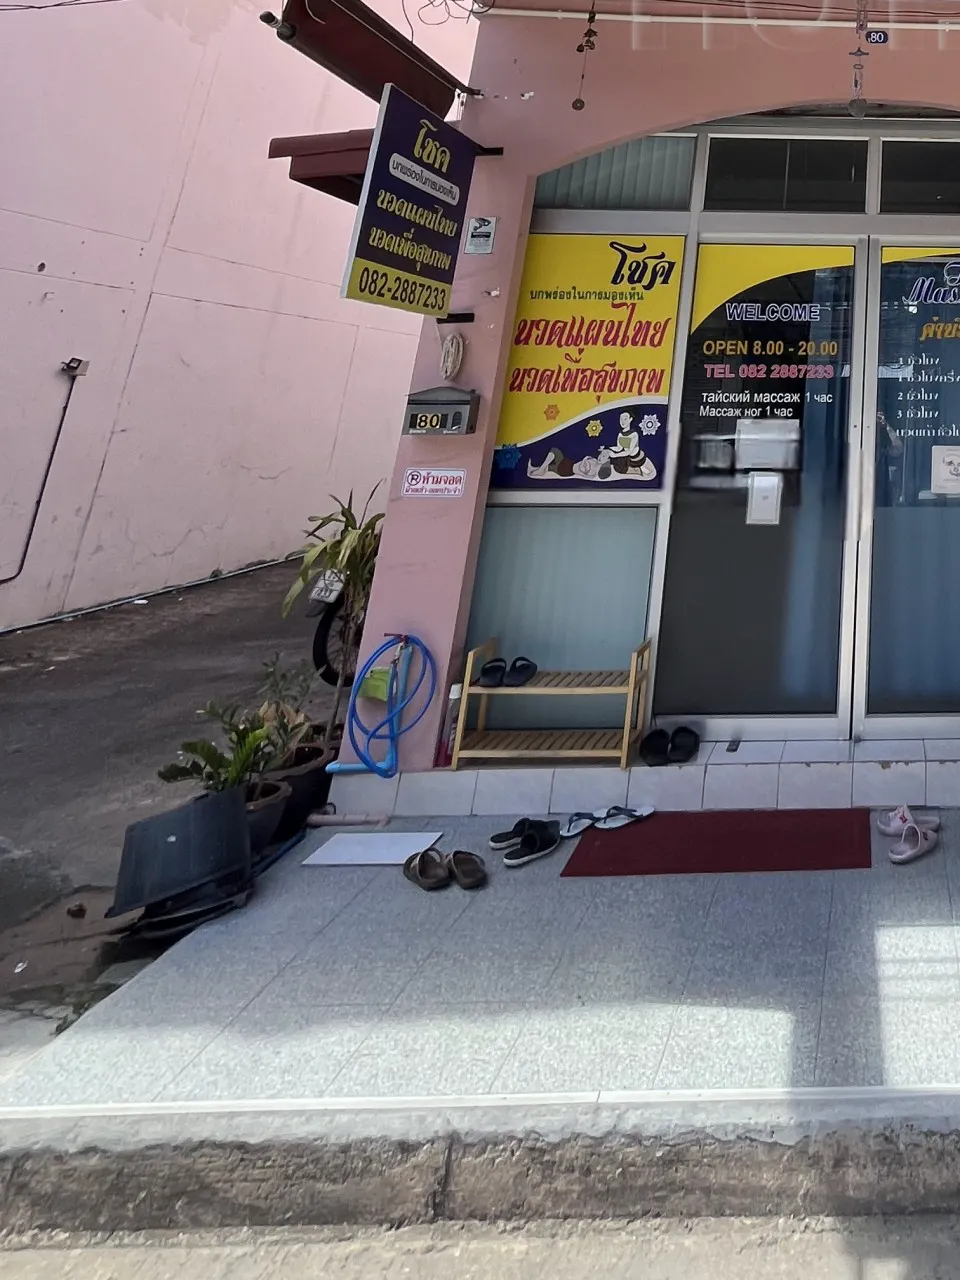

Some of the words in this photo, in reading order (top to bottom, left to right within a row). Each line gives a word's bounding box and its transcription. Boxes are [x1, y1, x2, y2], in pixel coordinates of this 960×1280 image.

[870, 32, 884, 42] 80
[413, 119, 450, 173] โชค
[376, 189, 458, 237] นวดแผนไทย
[368, 226, 452, 272] นวดเพื่อสุขภาพ
[609, 241, 676, 291] โชค
[358, 267, 446, 311] 082-2887233
[530, 286, 644, 301] บกพร่องในการมองเห็น
[725, 302, 820, 322] WELCOME
[514, 302, 672, 349] นวดแผนไทย
[703, 340, 748, 355] OPEN
[752, 340, 784, 356] 8.00
[798, 341, 838, 356] 20.00
[509, 353, 666, 403] นวดเพื่อสุขภาพ
[704, 364, 735, 378] TEL
[738, 364, 767, 378] 082
[770, 364, 835, 379] 2887233
[702, 390, 750, 403] тайский
[753, 392, 801, 403] массаж
[805, 392, 810, 402] 1
[814, 394, 833, 403] час
[897, 392, 903, 400] 2
[699, 405, 742, 417] Массаж
[744, 407, 762, 417] ног
[766, 406, 770, 417] 1
[774, 408, 793, 417] час
[896, 410, 903, 419] 3
[418, 414, 440, 429] 80
[422, 472, 463, 486] ห้ามจอด
